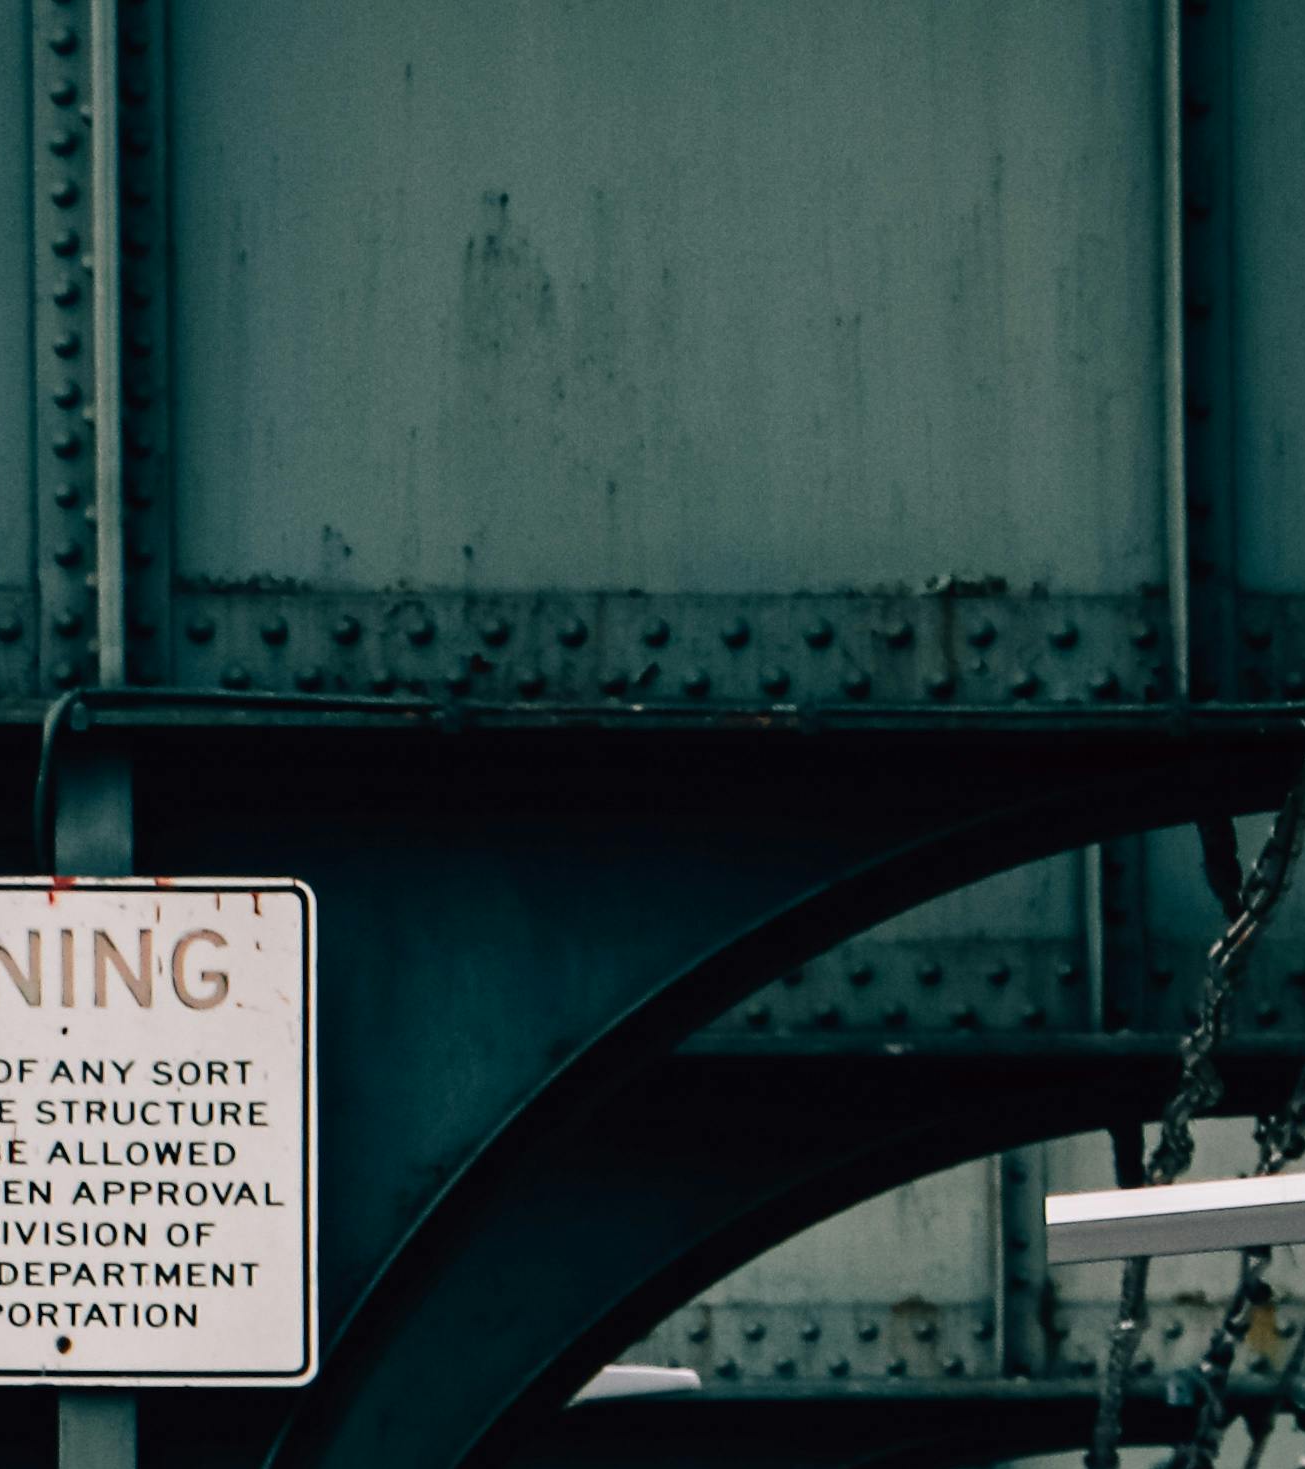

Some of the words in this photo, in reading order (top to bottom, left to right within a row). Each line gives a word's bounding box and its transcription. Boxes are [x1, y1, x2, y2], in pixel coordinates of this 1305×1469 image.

[50, 1060, 134, 1085] ANY
[152, 1061, 252, 1086] SORT
[36, 1101, 268, 1127] STRUCTURE
[47, 1141, 236, 1167] ALLOWED
[72, 1182, 284, 1207] APPROVAL
[166, 1223, 215, 1248] OF
